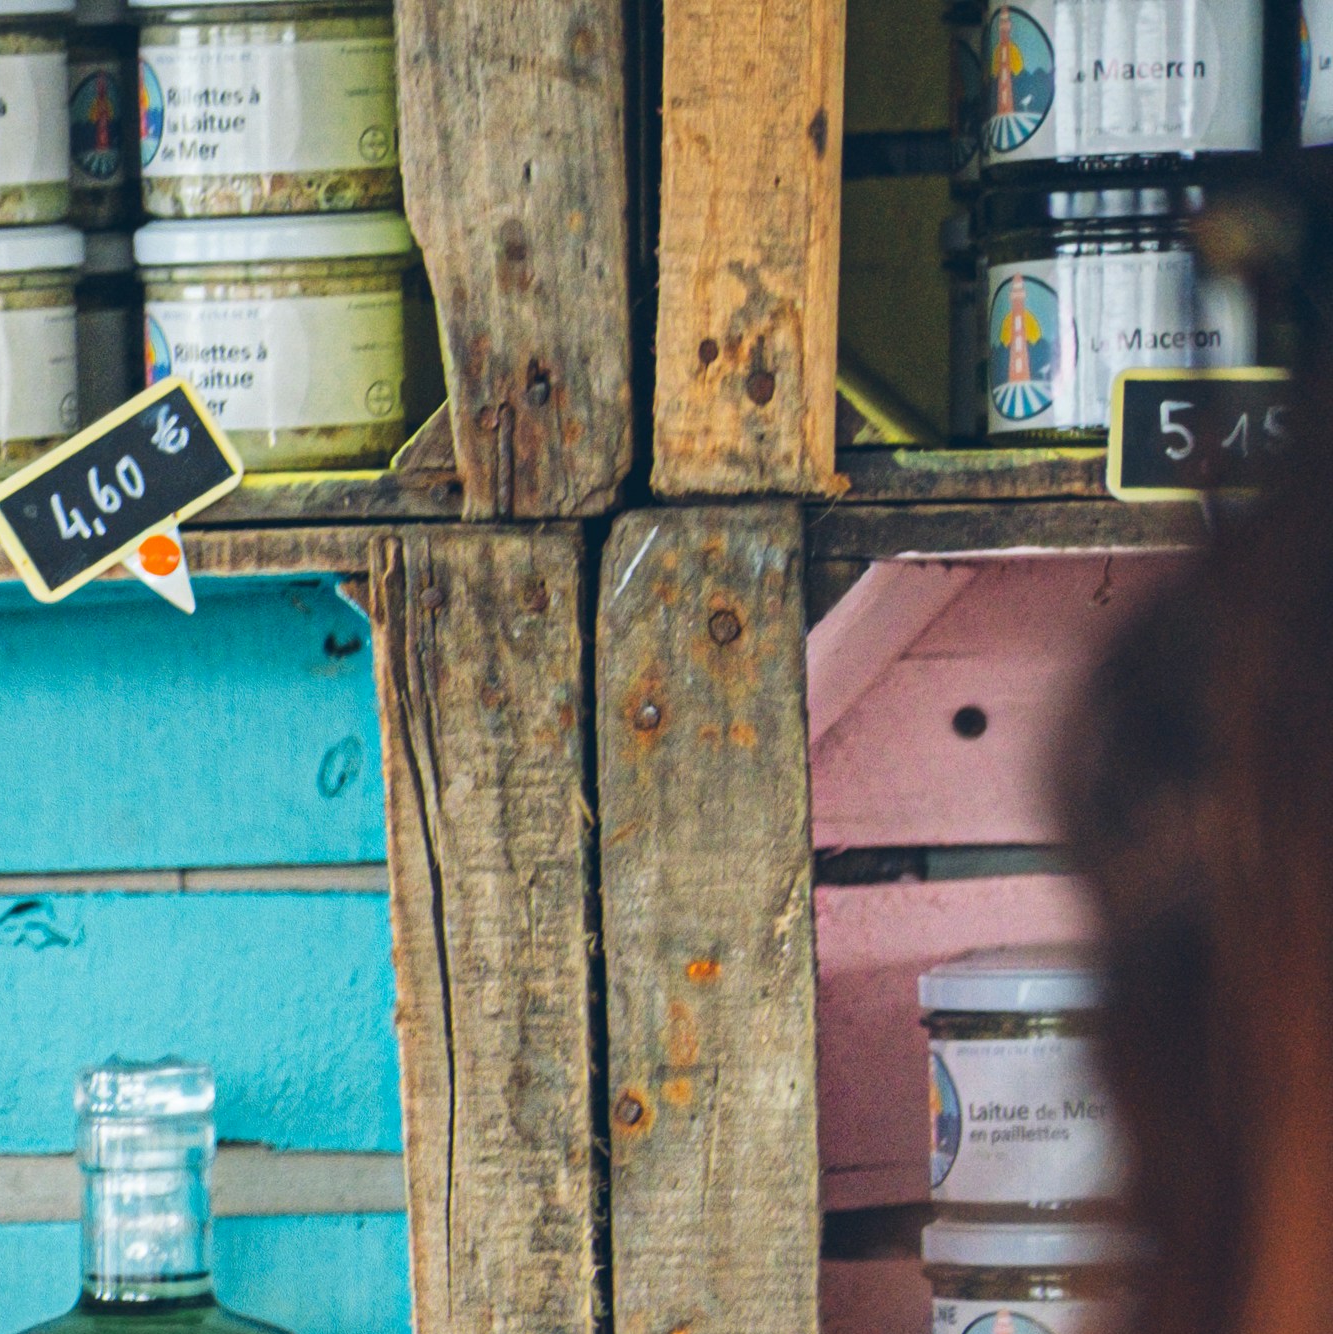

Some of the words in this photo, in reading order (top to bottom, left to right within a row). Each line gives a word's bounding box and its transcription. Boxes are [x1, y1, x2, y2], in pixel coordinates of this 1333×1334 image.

[1119, 327, 1221, 352] Maceon
[49, 453, 146, 541] 4,60
[968, 1100, 1030, 1122] Laitue
[1035, 1103, 1057, 1121] de
[991, 1125, 1070, 1145] paillettes
